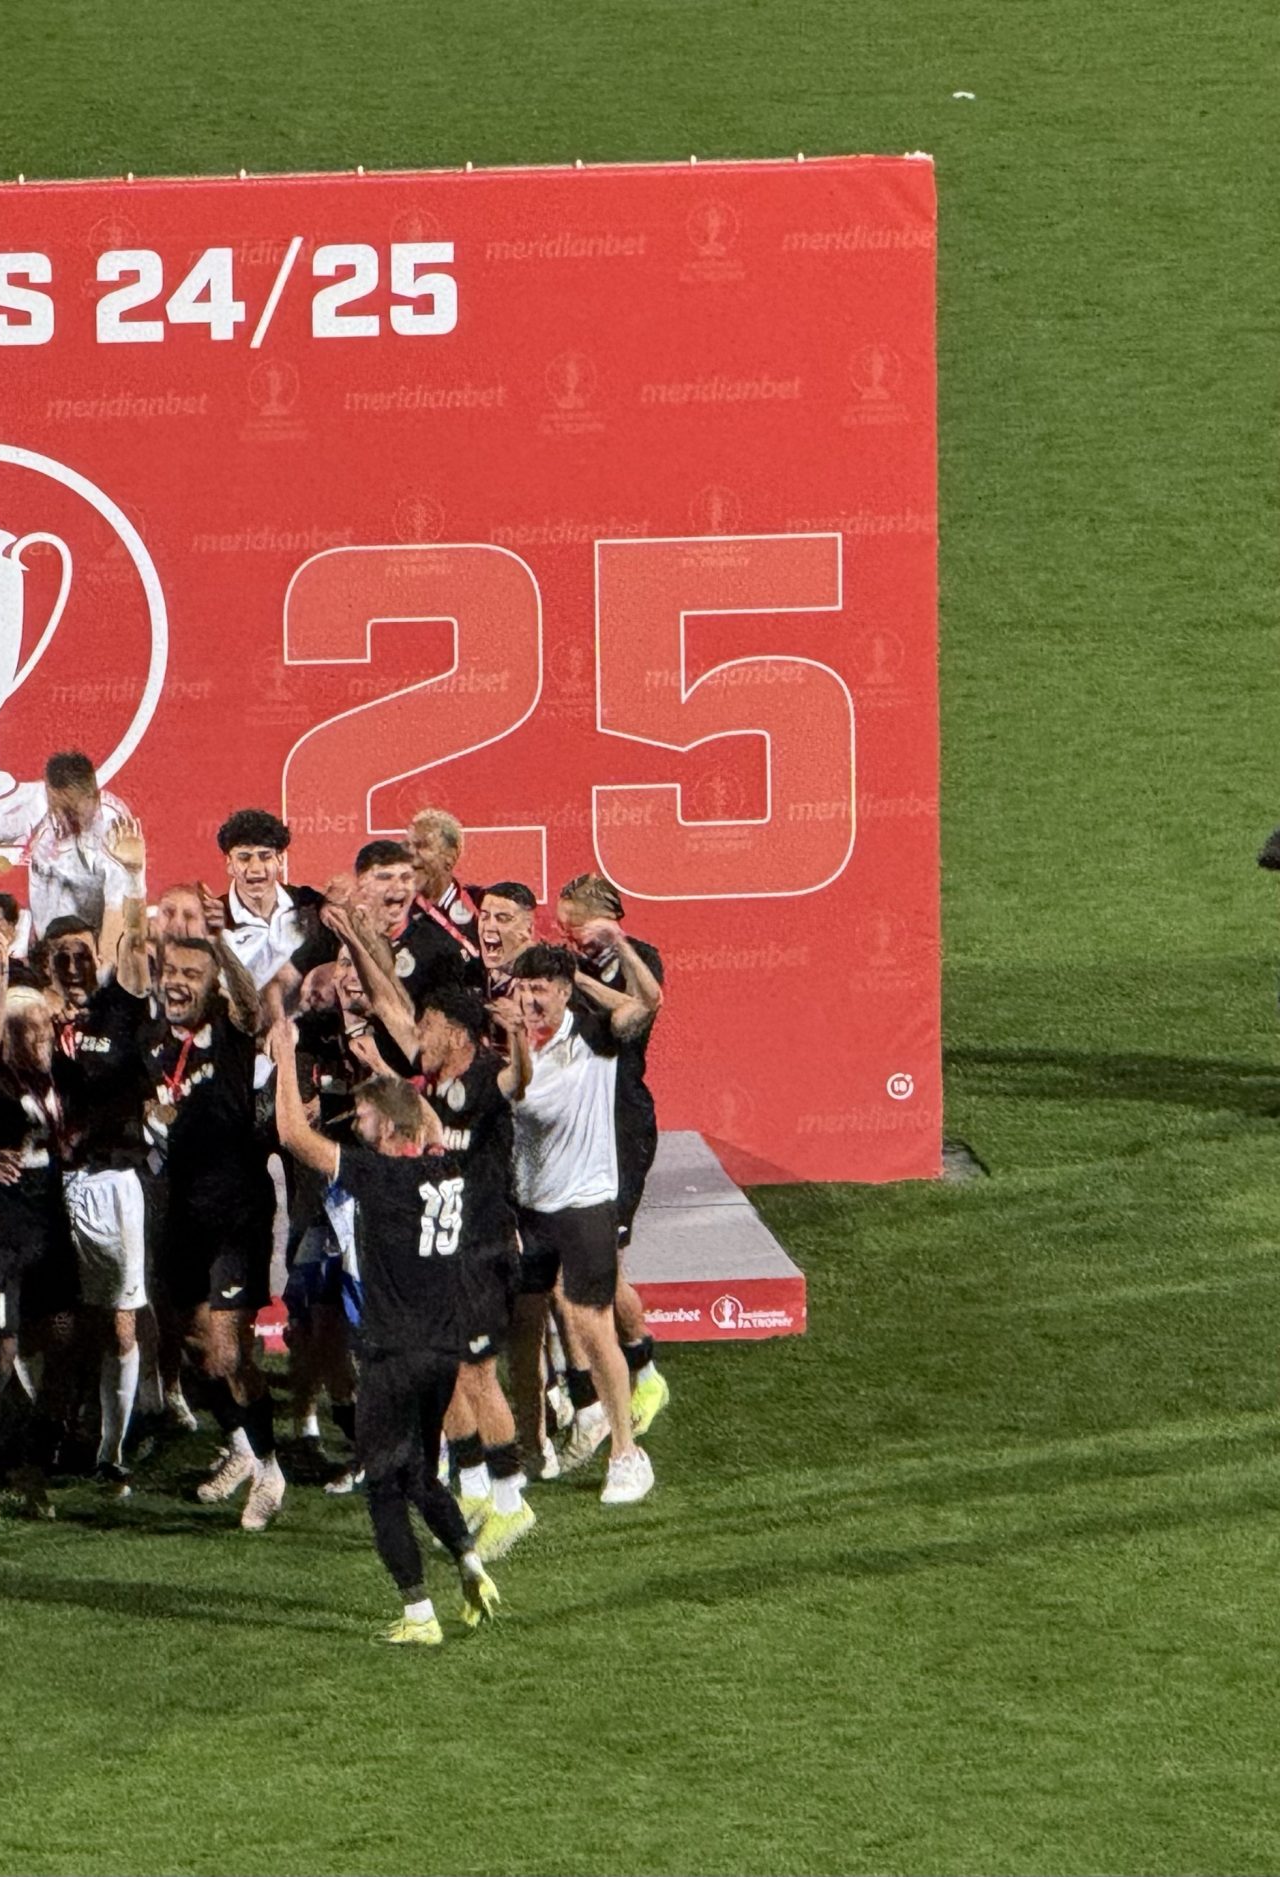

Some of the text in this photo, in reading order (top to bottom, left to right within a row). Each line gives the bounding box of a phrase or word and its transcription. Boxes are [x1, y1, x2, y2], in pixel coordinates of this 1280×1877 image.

[782, 224, 936, 252] meridianbe
[95, 235, 460, 350] 24/25
[641, 374, 803, 404] meridianbet
[281, 530, 857, 906] 25
